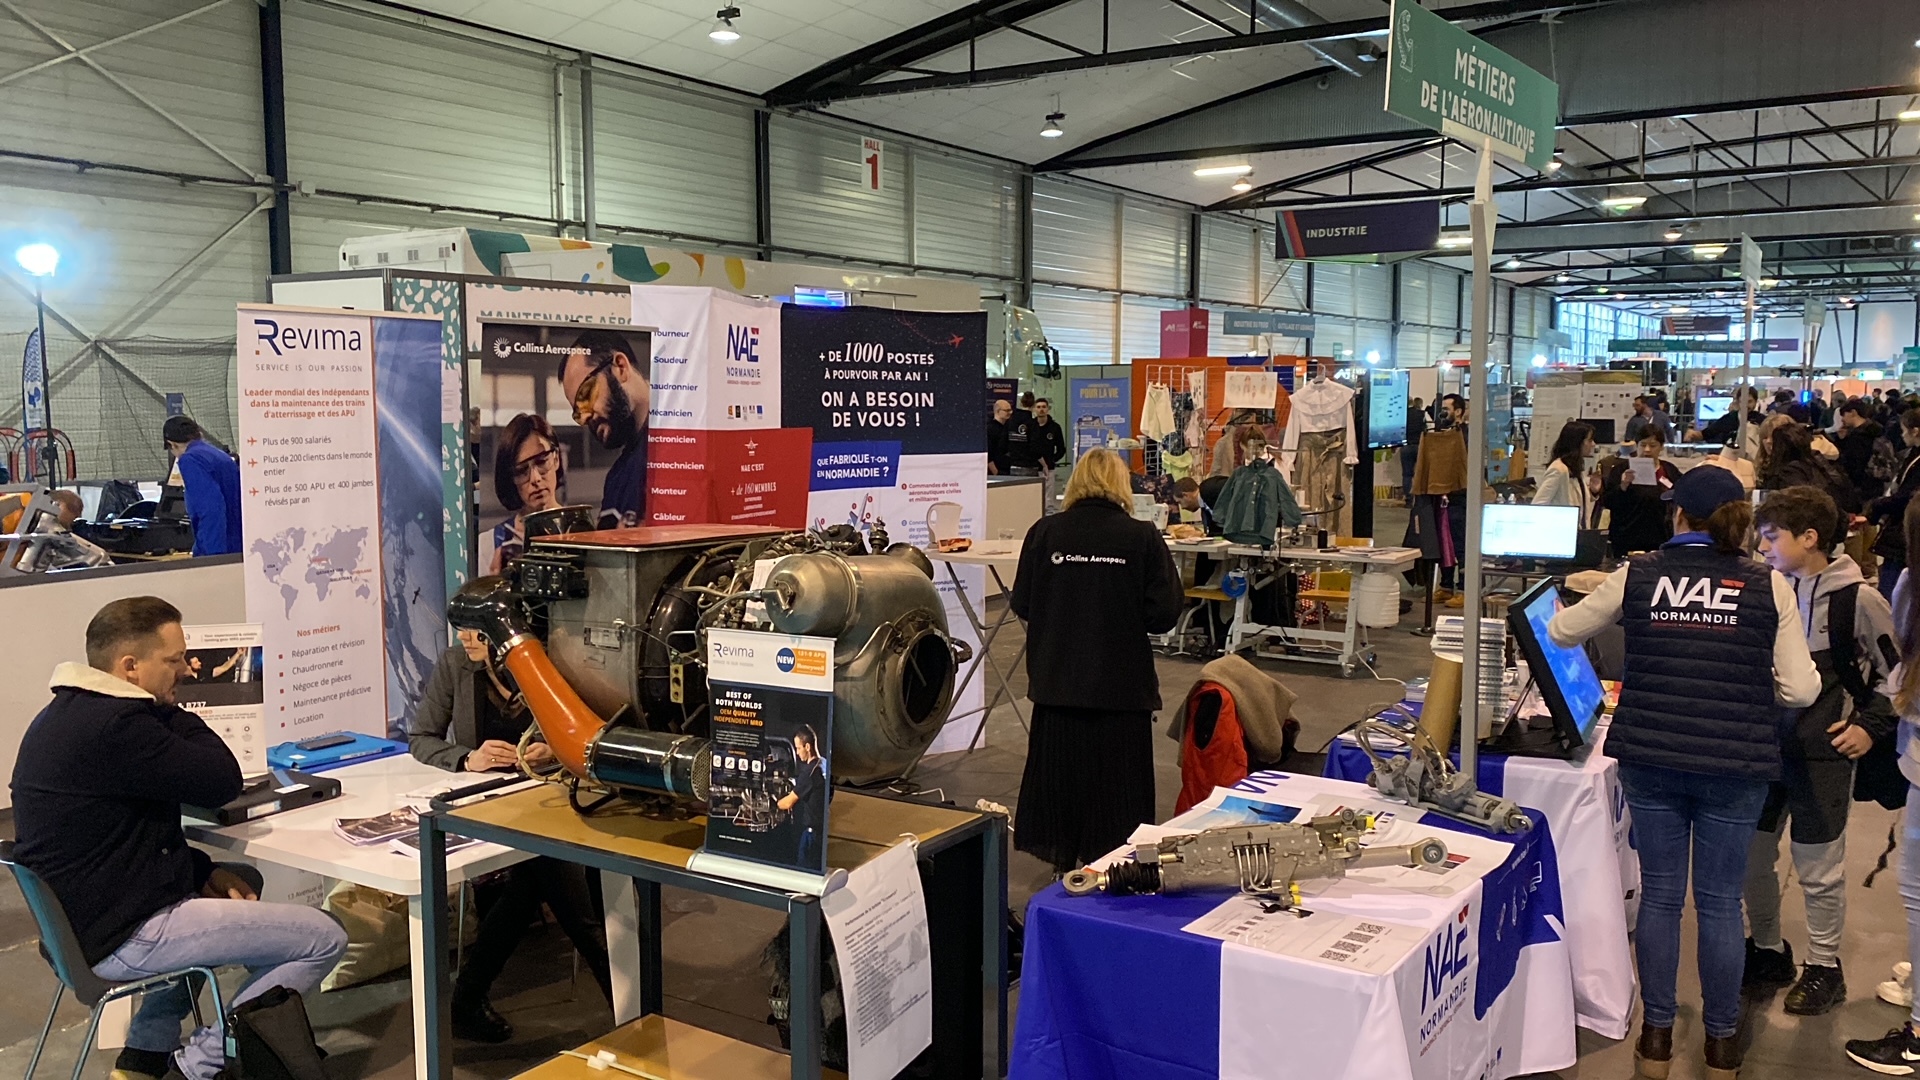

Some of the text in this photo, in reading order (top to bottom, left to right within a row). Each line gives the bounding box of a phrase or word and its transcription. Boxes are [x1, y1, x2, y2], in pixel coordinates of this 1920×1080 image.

[1455, 46, 1516, 106] MÉTIERS
[1421, 80, 1535, 153] DE L'AÉRONAUTIQUE
[864, 139, 880, 151] HALL
[866, 154, 878, 189] 1
[1306, 226, 1367, 238] INDUSTRIE
[254, 319, 361, 355] Revima
[727, 324, 759, 362] NAE
[514, 342, 591, 356] Collins Aerospace
[829, 351, 841, 362] DE
[844, 342, 884, 363] 1000
[887, 353, 934, 365] POSTES
[727, 367, 760, 378] NORMANDIE
[825, 368, 830, 380] À
[833, 370, 878, 380] POURVOIR
[881, 371, 901, 380] PAR
[905, 372, 920, 381] AN
[307, 388, 319, 396] des
[322, 389, 369, 397] indépendants
[822, 391, 934, 407] ON A BESOIN
[1080, 388, 1119, 398] POUR LA VIE
[264, 411, 315, 419] d'atterrissage
[833, 412, 920, 427] DE VOUS !
[263, 437, 278, 445] Plus
[280, 437, 289, 445] de
[305, 436, 331, 444] salariés
[648, 435, 696, 443] lectronicien
[264, 455, 278, 463] Plus
[290, 454, 302, 462] 200
[303, 453, 325, 461] clients
[817, 458, 828, 466] QUE
[829, 454, 869, 465] FABRIQUE
[264, 468, 285, 476] entier
[825, 467, 880, 480] NORMANDIE
[883, 466, 889, 477] ?
[265, 485, 280, 493] Plus
[352, 480, 374, 489] jambes
[755, 482, 776, 493] MEMBRES
[265, 498, 288, 506] révisés
[653, 513, 685, 521] Câbleur
[1066, 554, 1126, 564] Collins Aerospace
[1651, 576, 1745, 610] NAE
[1651, 611, 1738, 625] NORMANDIE
[297, 624, 340, 637] Nos métiers
[292, 638, 365, 659] Réparation et révision
[714, 643, 754, 657] Revima
[292, 658, 343, 675] Chaudronnerie
[777, 656, 794, 664] NEW
[293, 673, 352, 693] Négoce de pièces
[294, 685, 371, 709] Maintenance prédictive
[735, 701, 762, 709] WORLDS
[294, 712, 324, 726] Location
[714, 716, 749, 725] INDEPENDENT
[733, 710, 756, 718] QUALITY
[1422, 903, 1469, 1016] NAE
[1420, 976, 1468, 1044] NORMANDIE
